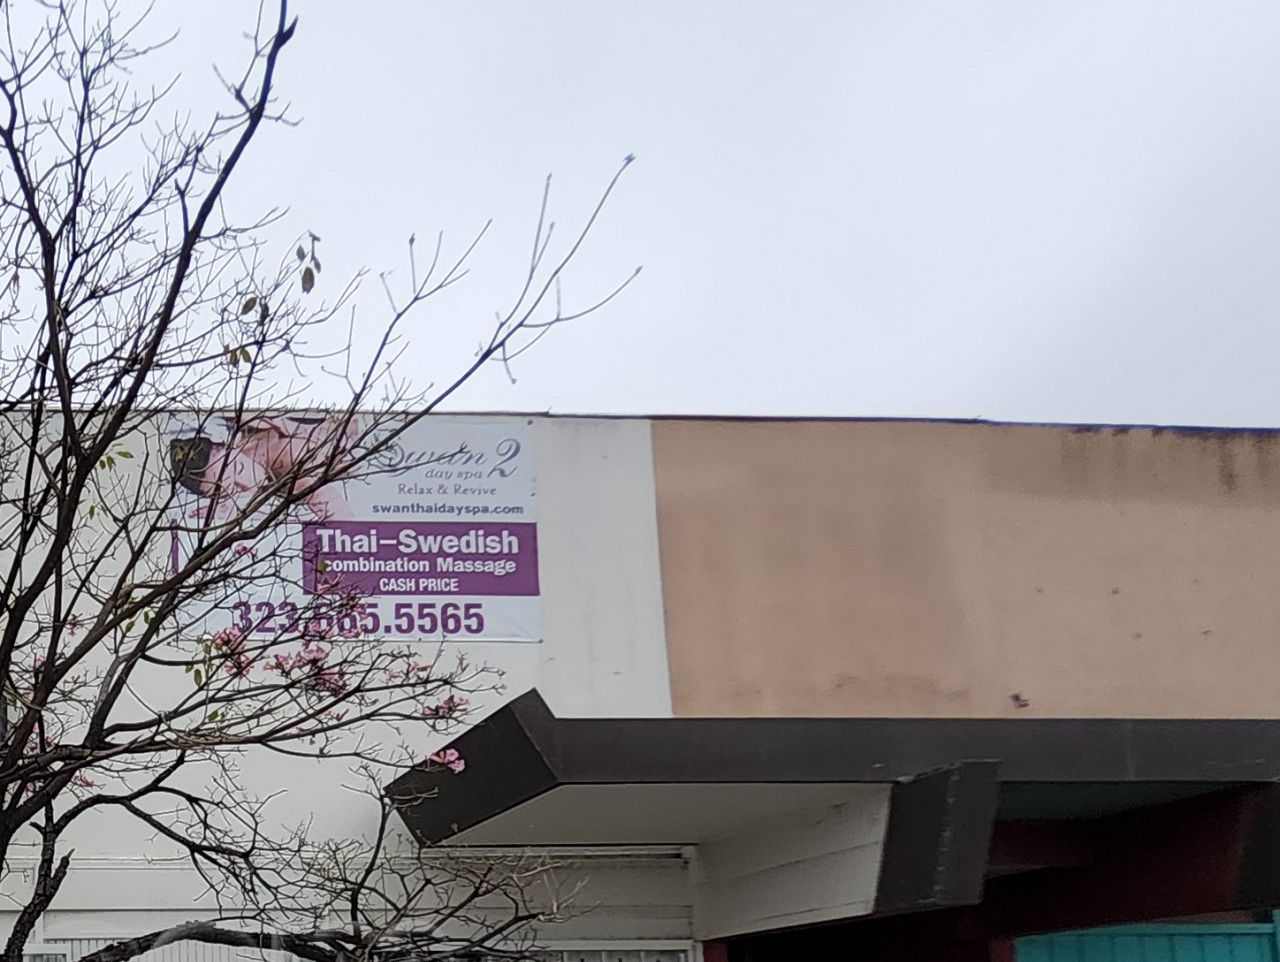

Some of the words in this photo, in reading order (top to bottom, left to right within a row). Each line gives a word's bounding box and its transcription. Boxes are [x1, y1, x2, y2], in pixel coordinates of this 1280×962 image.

[487, 438, 521, 478] 2
[425, 469, 453, 480] day
[456, 470, 483, 480] spa
[397, 483, 433, 495] Relax
[437, 484, 449, 495] &
[453, 484, 497, 495] Revive
[371, 502, 524, 516] swanthaidayspa.com
[316, 529, 519, 554] Thai-Swedish
[436, 557, 517, 576] Massage
[379, 578, 416, 591] CASH
[419, 578, 460, 591] PRICE
[232, 601, 485, 635] 323665.5565
